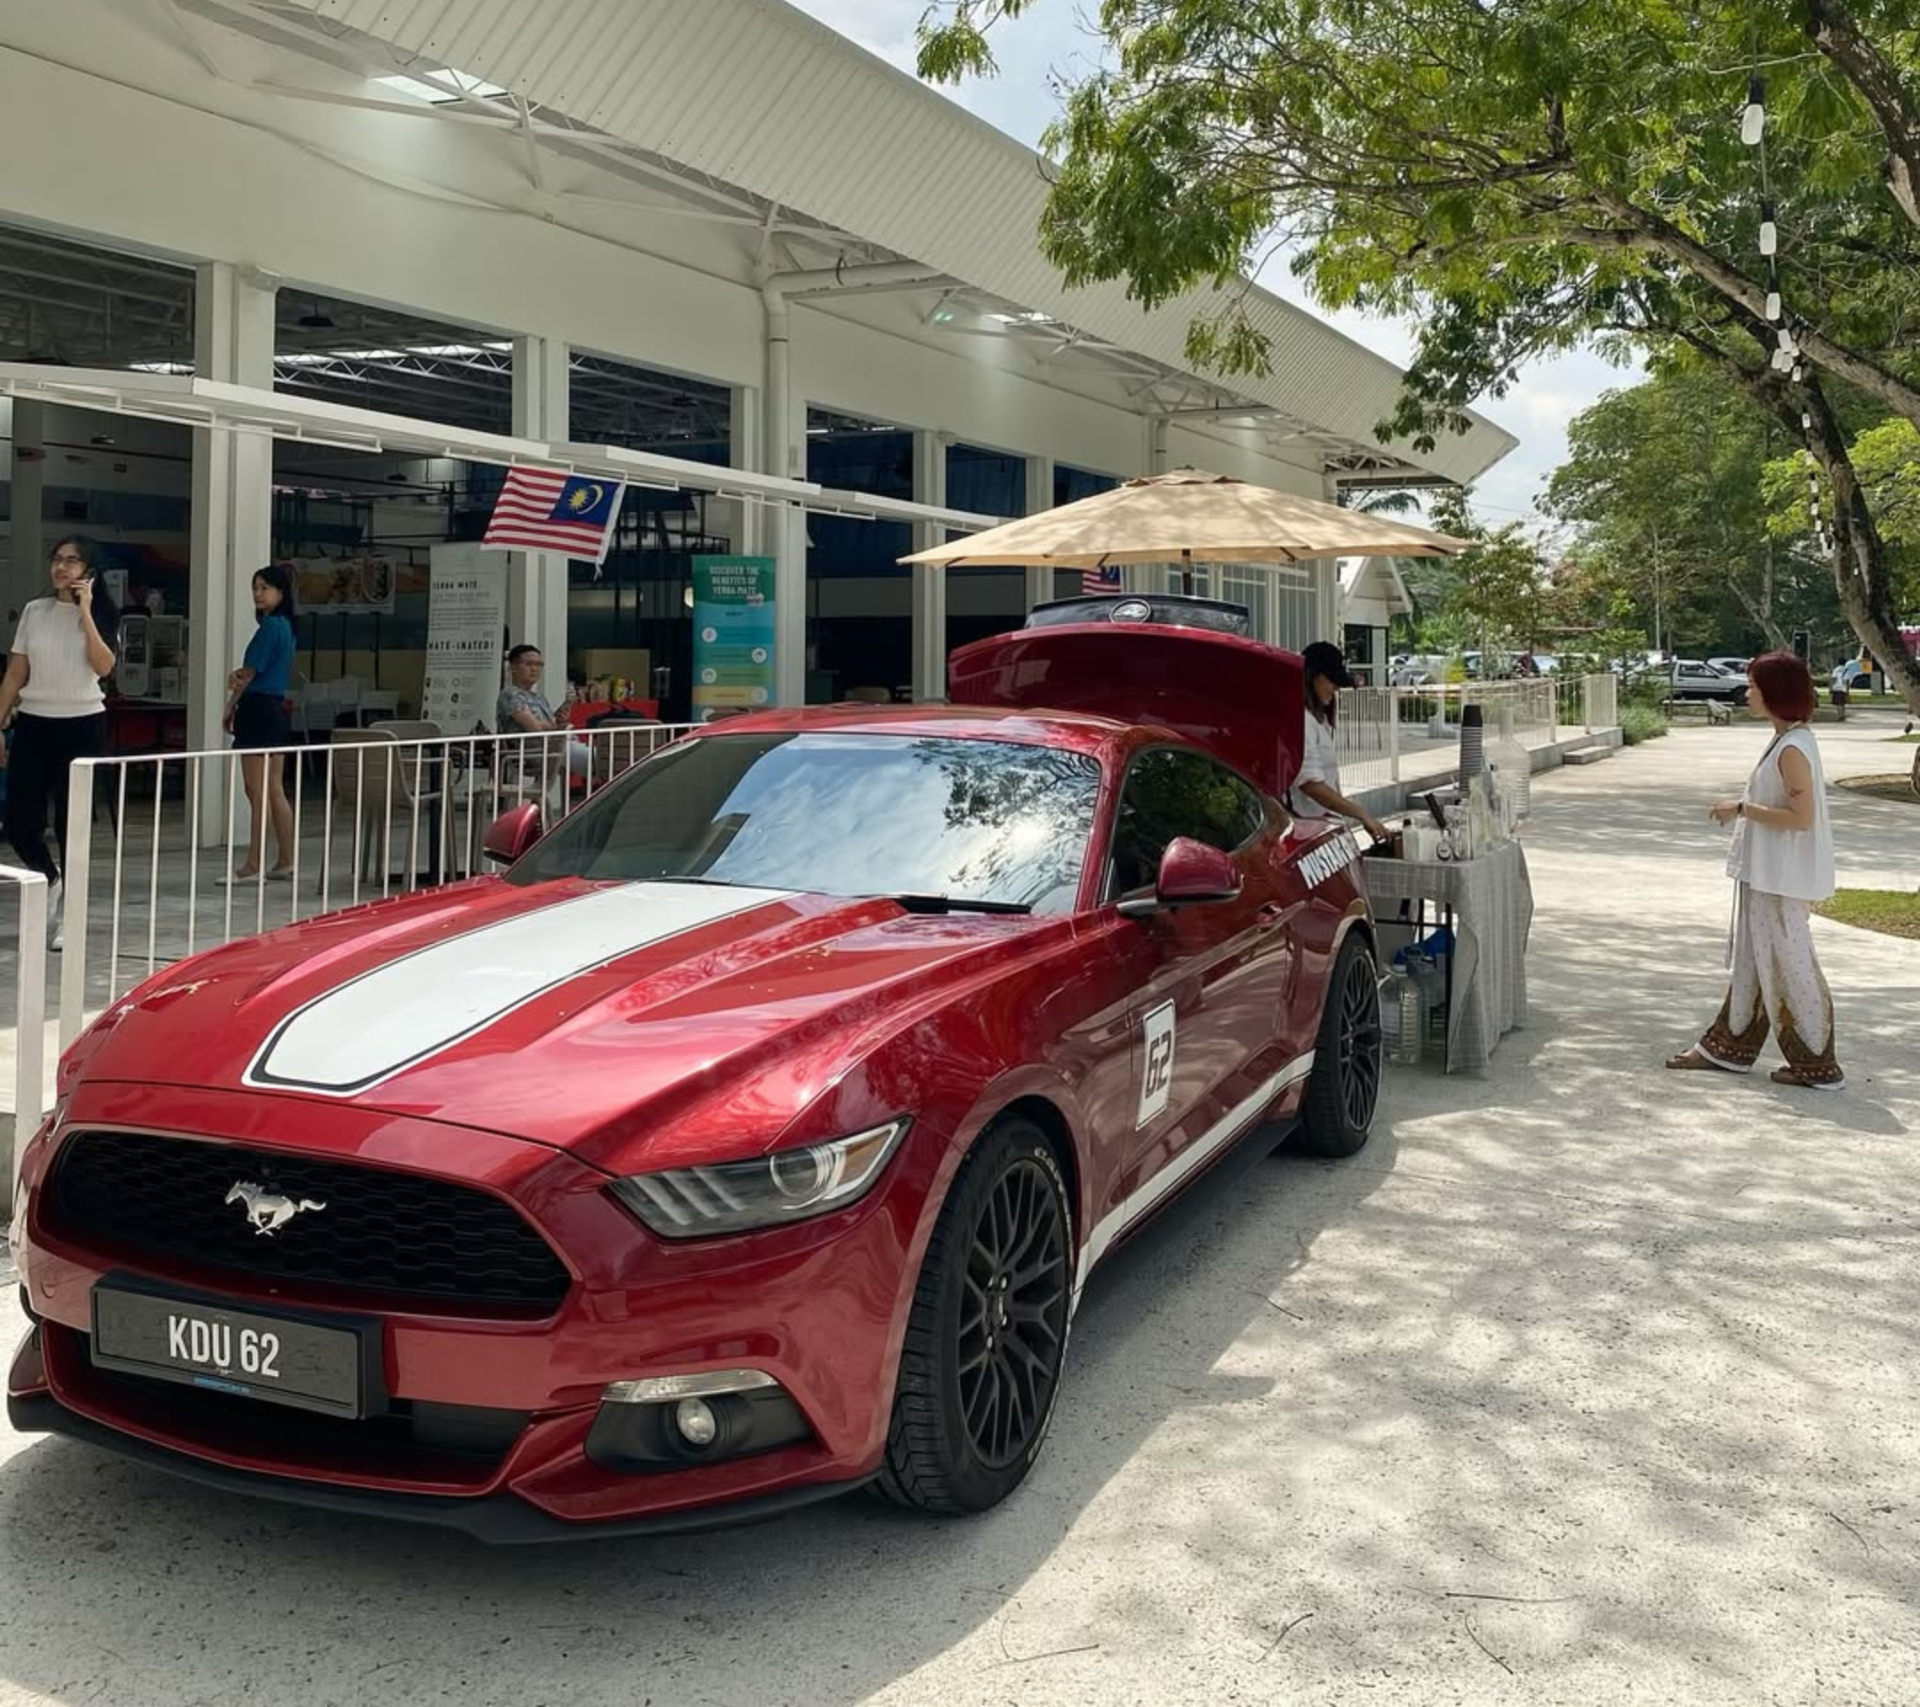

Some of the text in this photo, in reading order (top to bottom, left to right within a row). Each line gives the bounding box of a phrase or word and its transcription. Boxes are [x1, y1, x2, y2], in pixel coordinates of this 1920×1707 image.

[1145, 1029, 1171, 1099] 62
[168, 1315, 280, 1378] KDU 62
